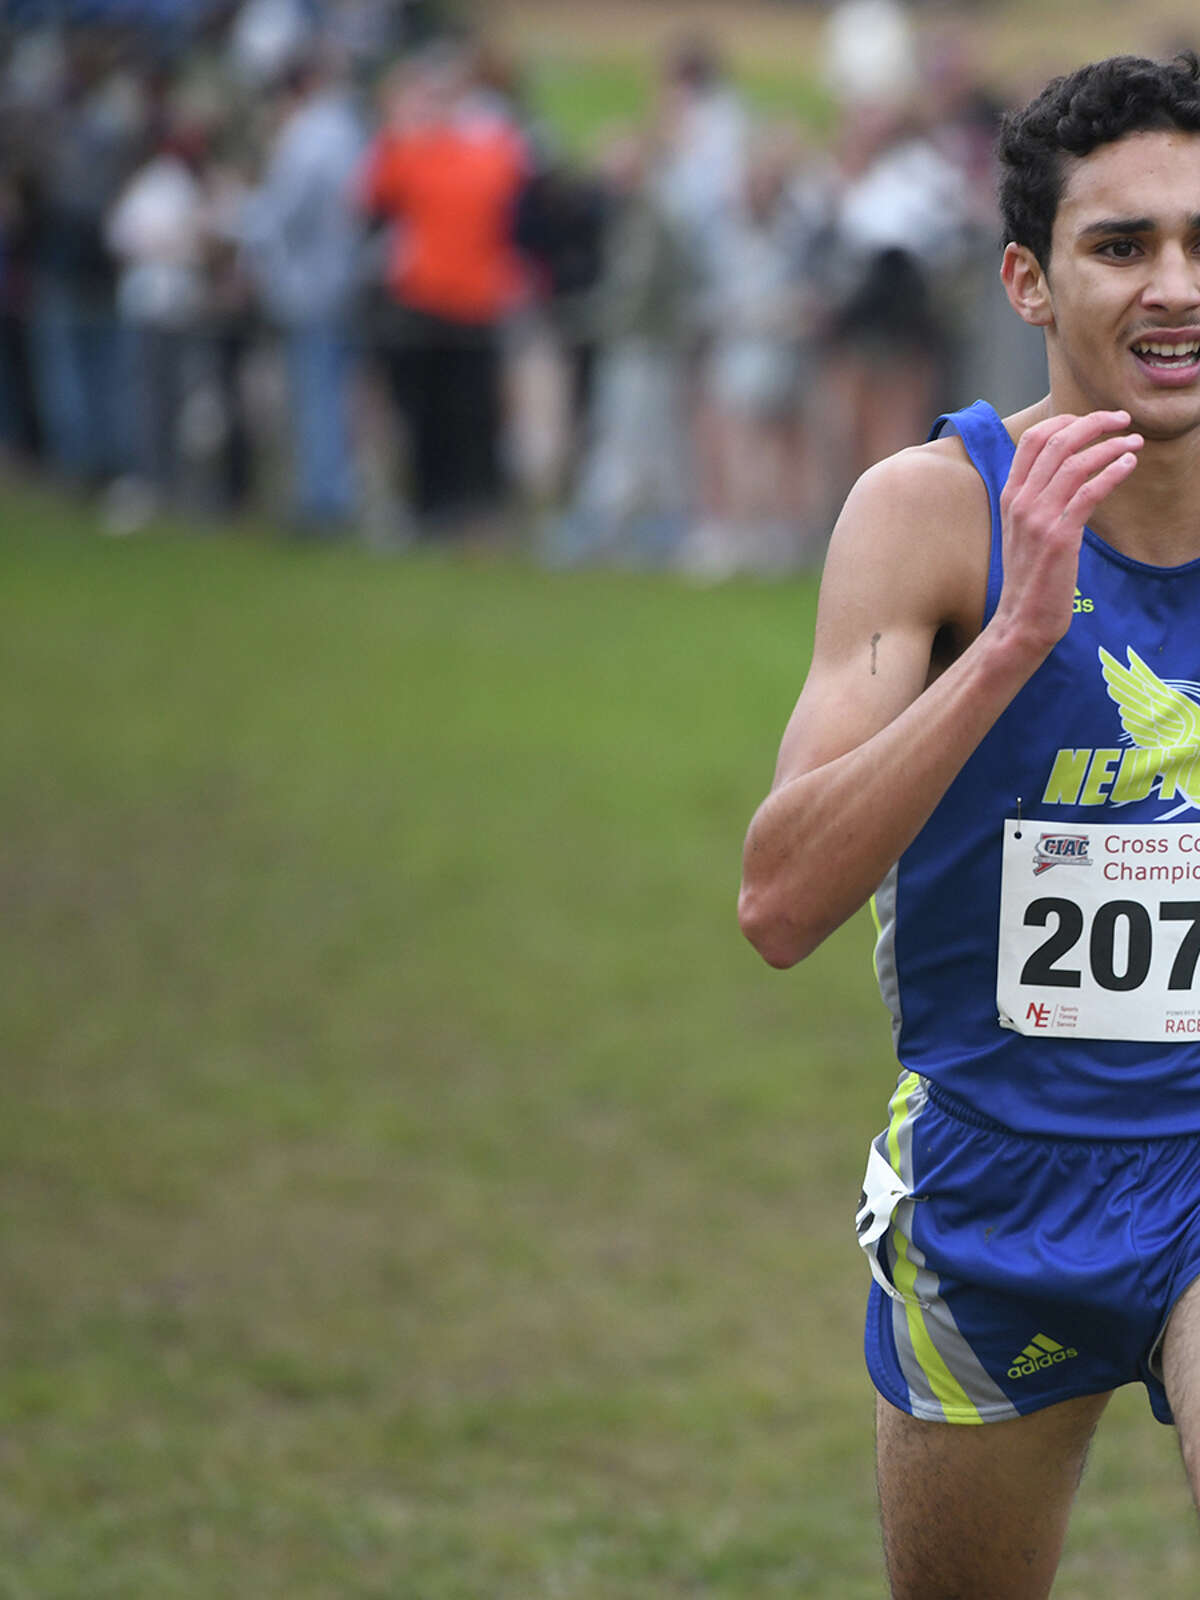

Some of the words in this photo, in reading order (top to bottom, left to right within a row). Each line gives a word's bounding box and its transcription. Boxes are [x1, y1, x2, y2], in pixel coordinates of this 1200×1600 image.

[1044, 838, 1090, 856] CIAC
[1104, 835, 1169, 853] Cross
[1026, 1002, 1051, 1028] NE
[1007, 1346, 1078, 1379] adidas
